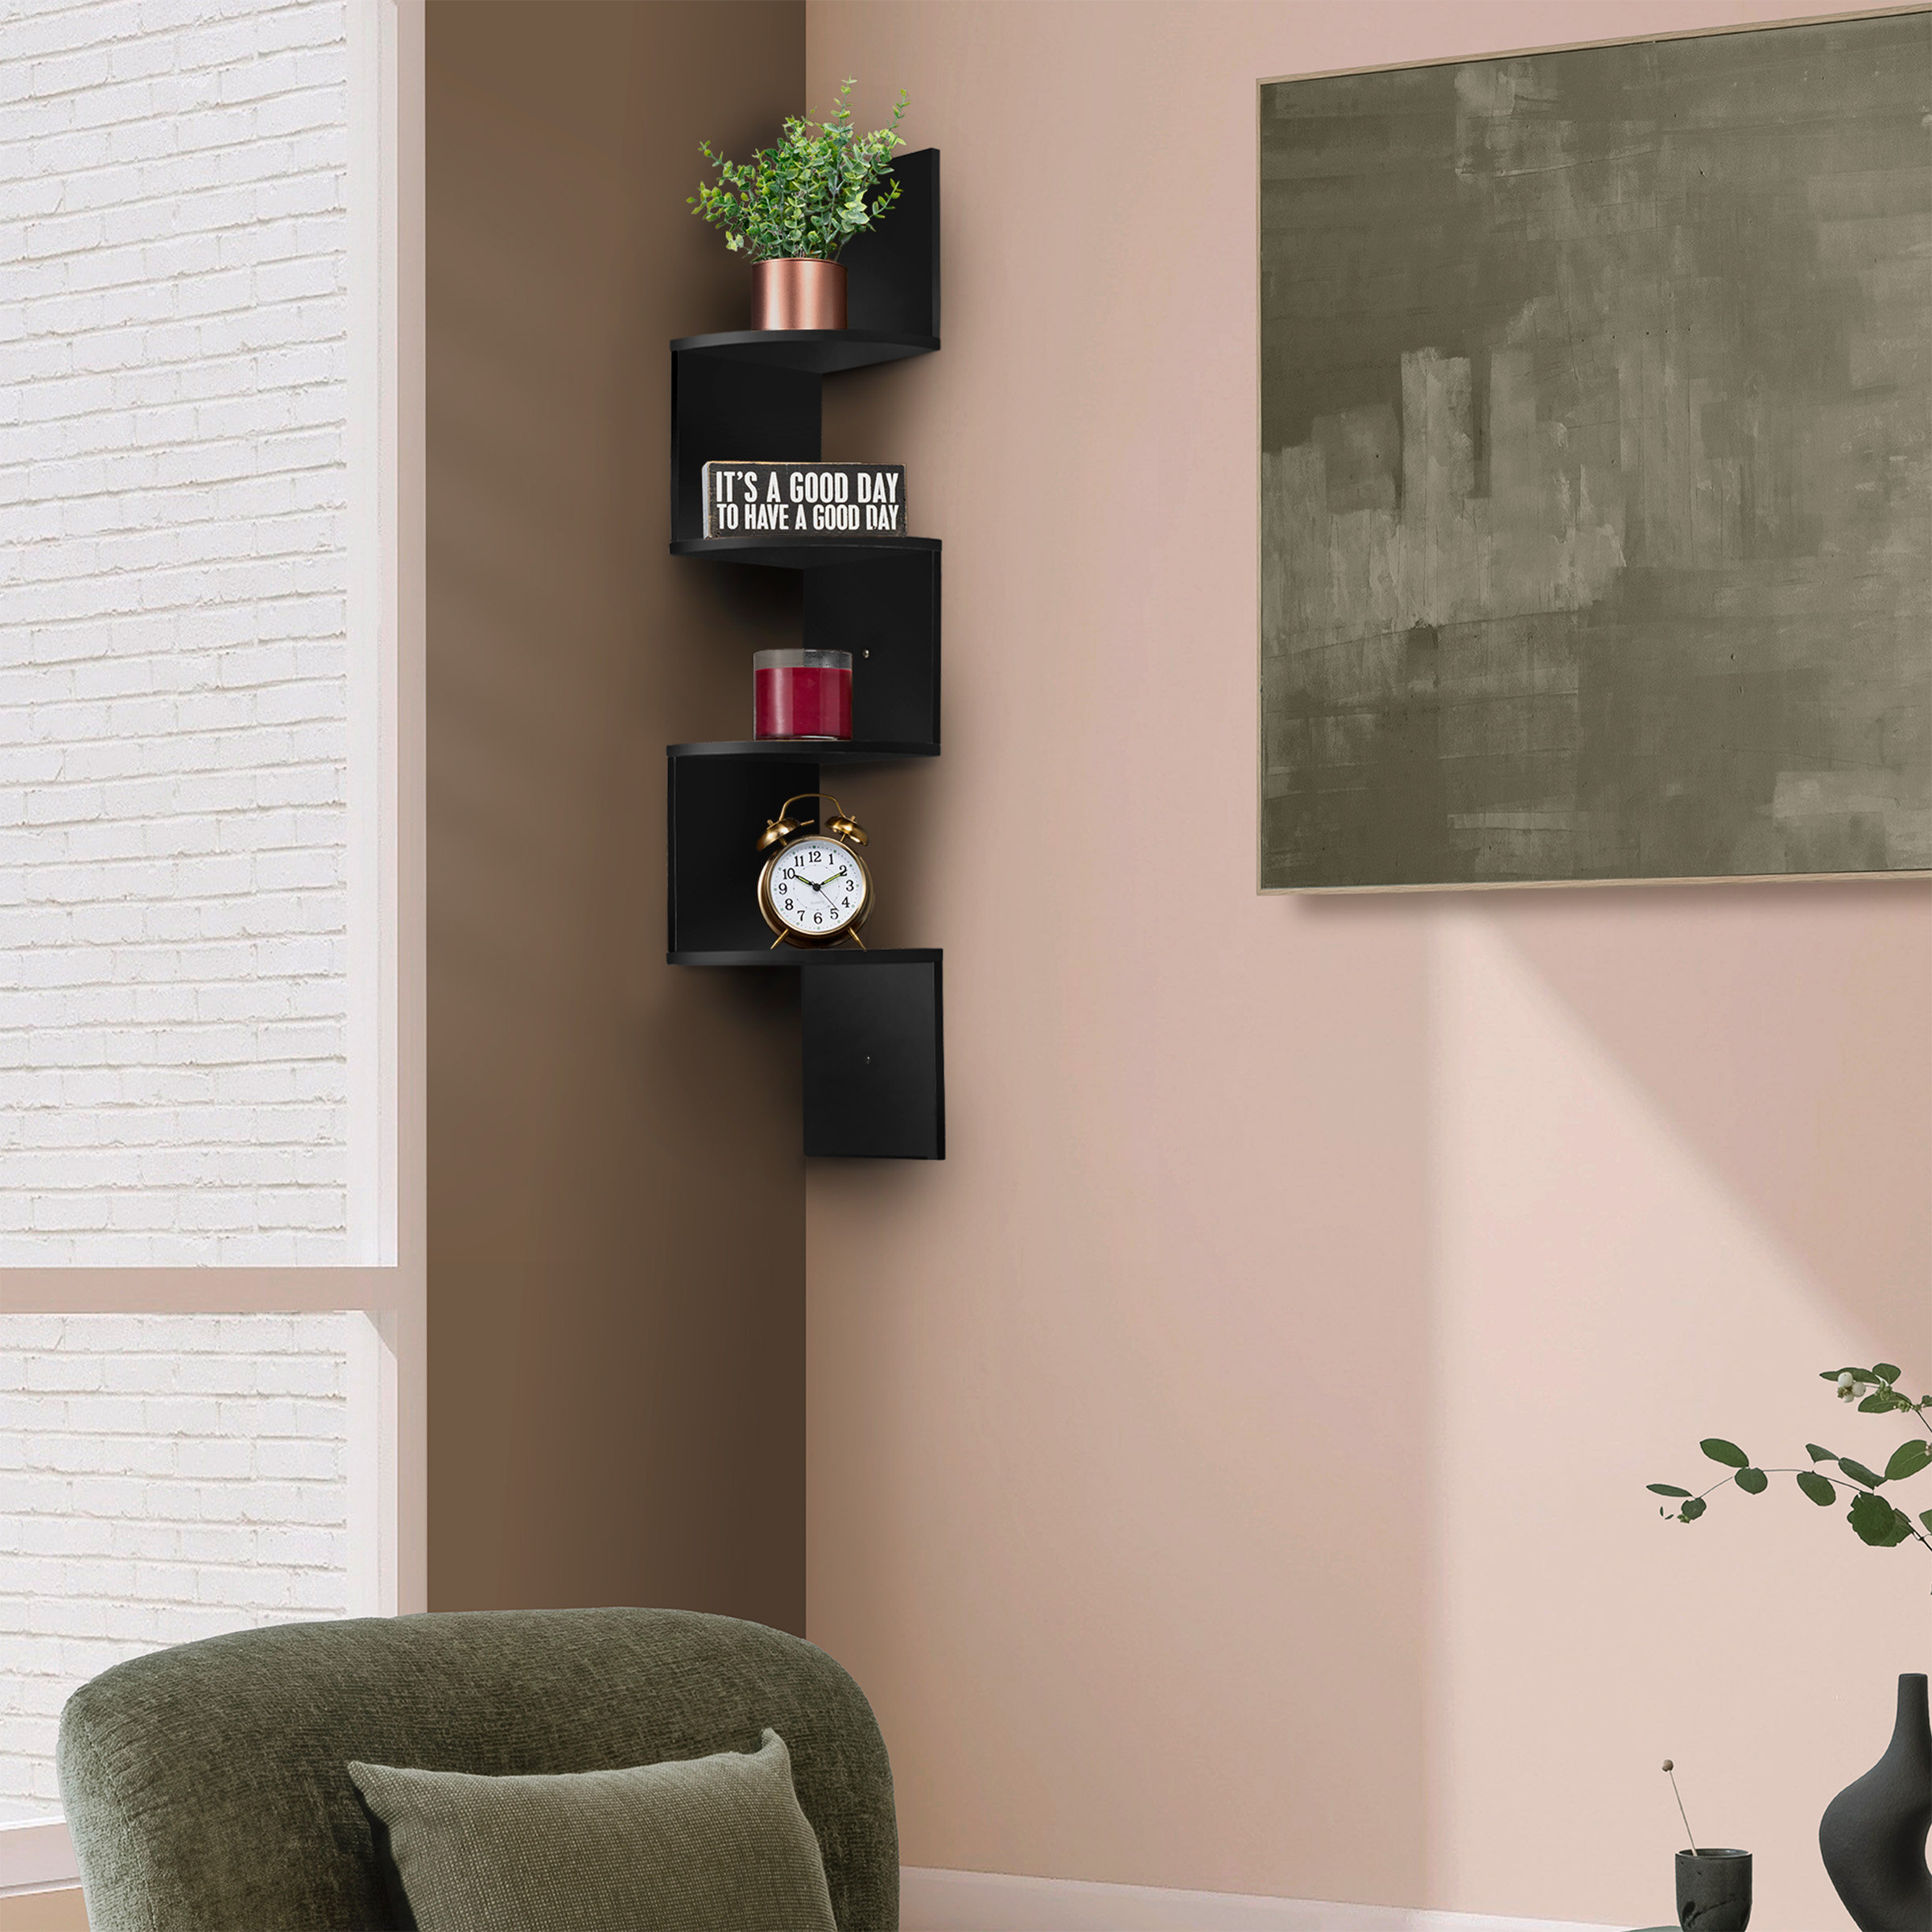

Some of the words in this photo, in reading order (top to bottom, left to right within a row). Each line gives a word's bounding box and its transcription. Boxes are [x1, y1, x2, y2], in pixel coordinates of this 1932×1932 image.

[716, 471, 758, 503] IT'S
[766, 472, 781, 503] A
[790, 472, 849, 504] GOOD
[857, 473, 899, 504] DAY
[716, 503, 739, 530] TO
[744, 504, 790, 530] HAVE
[795, 504, 807, 530] A
[812, 504, 860, 530] GOOD
[865, 505, 899, 530] DAY
[794, 855, 804, 867] 11
[808, 851, 822, 863] 12
[828, 853, 834, 865] 1
[782, 867, 795, 880] 10
[839, 865, 848, 877] 2
[778, 882, 787, 895] 9
[845, 879, 854, 891] 3
[784, 898, 794, 910] 8
[841, 896, 850, 908] 4
[797, 910, 805, 922] 7
[813, 911, 823, 924] 6
[830, 908, 839, 920] 5
